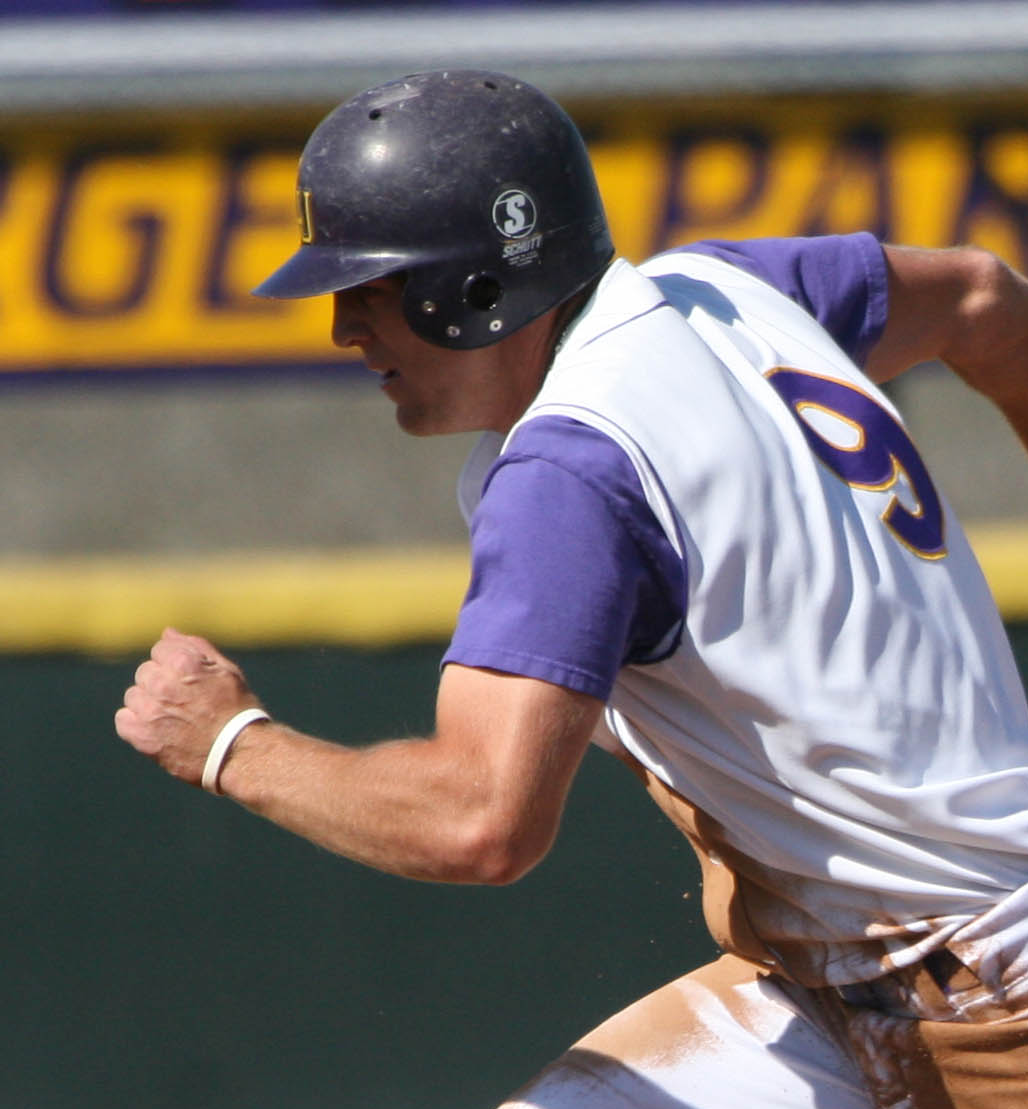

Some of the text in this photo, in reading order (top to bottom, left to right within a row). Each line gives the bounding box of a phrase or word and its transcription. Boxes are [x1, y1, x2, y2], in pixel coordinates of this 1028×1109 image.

[0, 138, 303, 322] GE
[496, 193, 534, 235] S
[764, 365, 948, 561] 9
